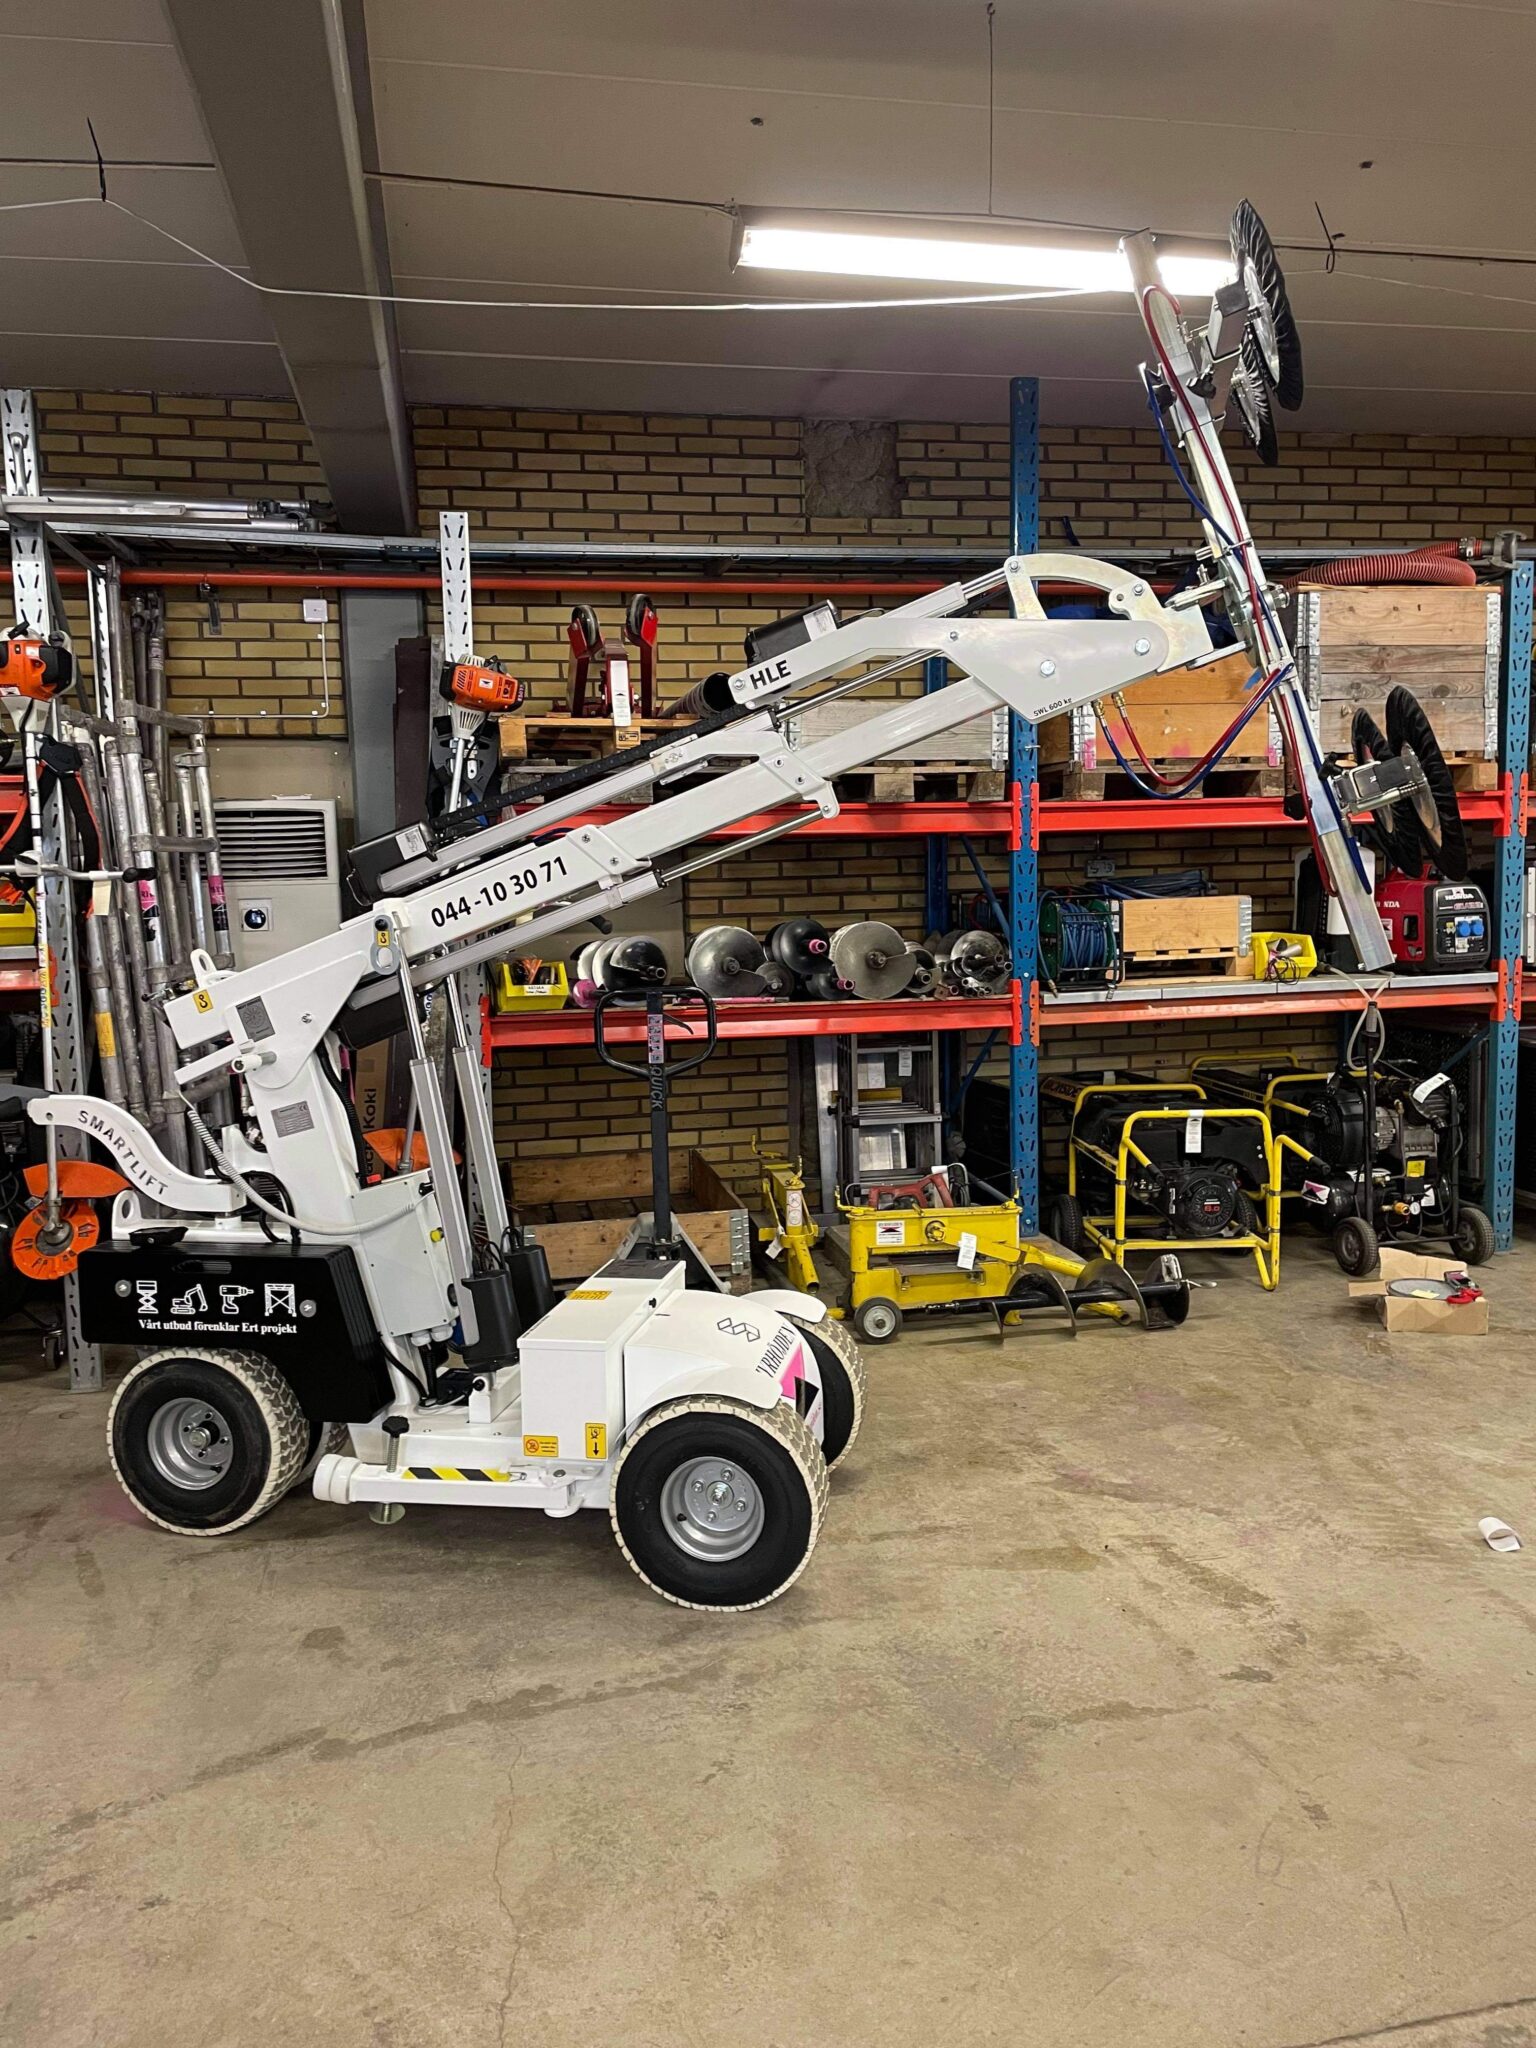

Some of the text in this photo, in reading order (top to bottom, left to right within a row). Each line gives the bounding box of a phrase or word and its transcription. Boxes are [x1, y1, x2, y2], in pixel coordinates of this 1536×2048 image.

[750, 659, 792, 690] HLE
[1033, 706, 1048, 717] SWL
[1048, 700, 1063, 711] 600
[431, 856, 567, 928] 044-10 30 71
[1375, 900, 1400, 908] NDA
[650, 1066, 664, 1109] QUICK
[362, 1088, 377, 1130] Koki
[78, 1110, 168, 1195] SMARTLIFT
[138, 1319, 298, 1336] Vårt utbud förenklar Ert projekt
